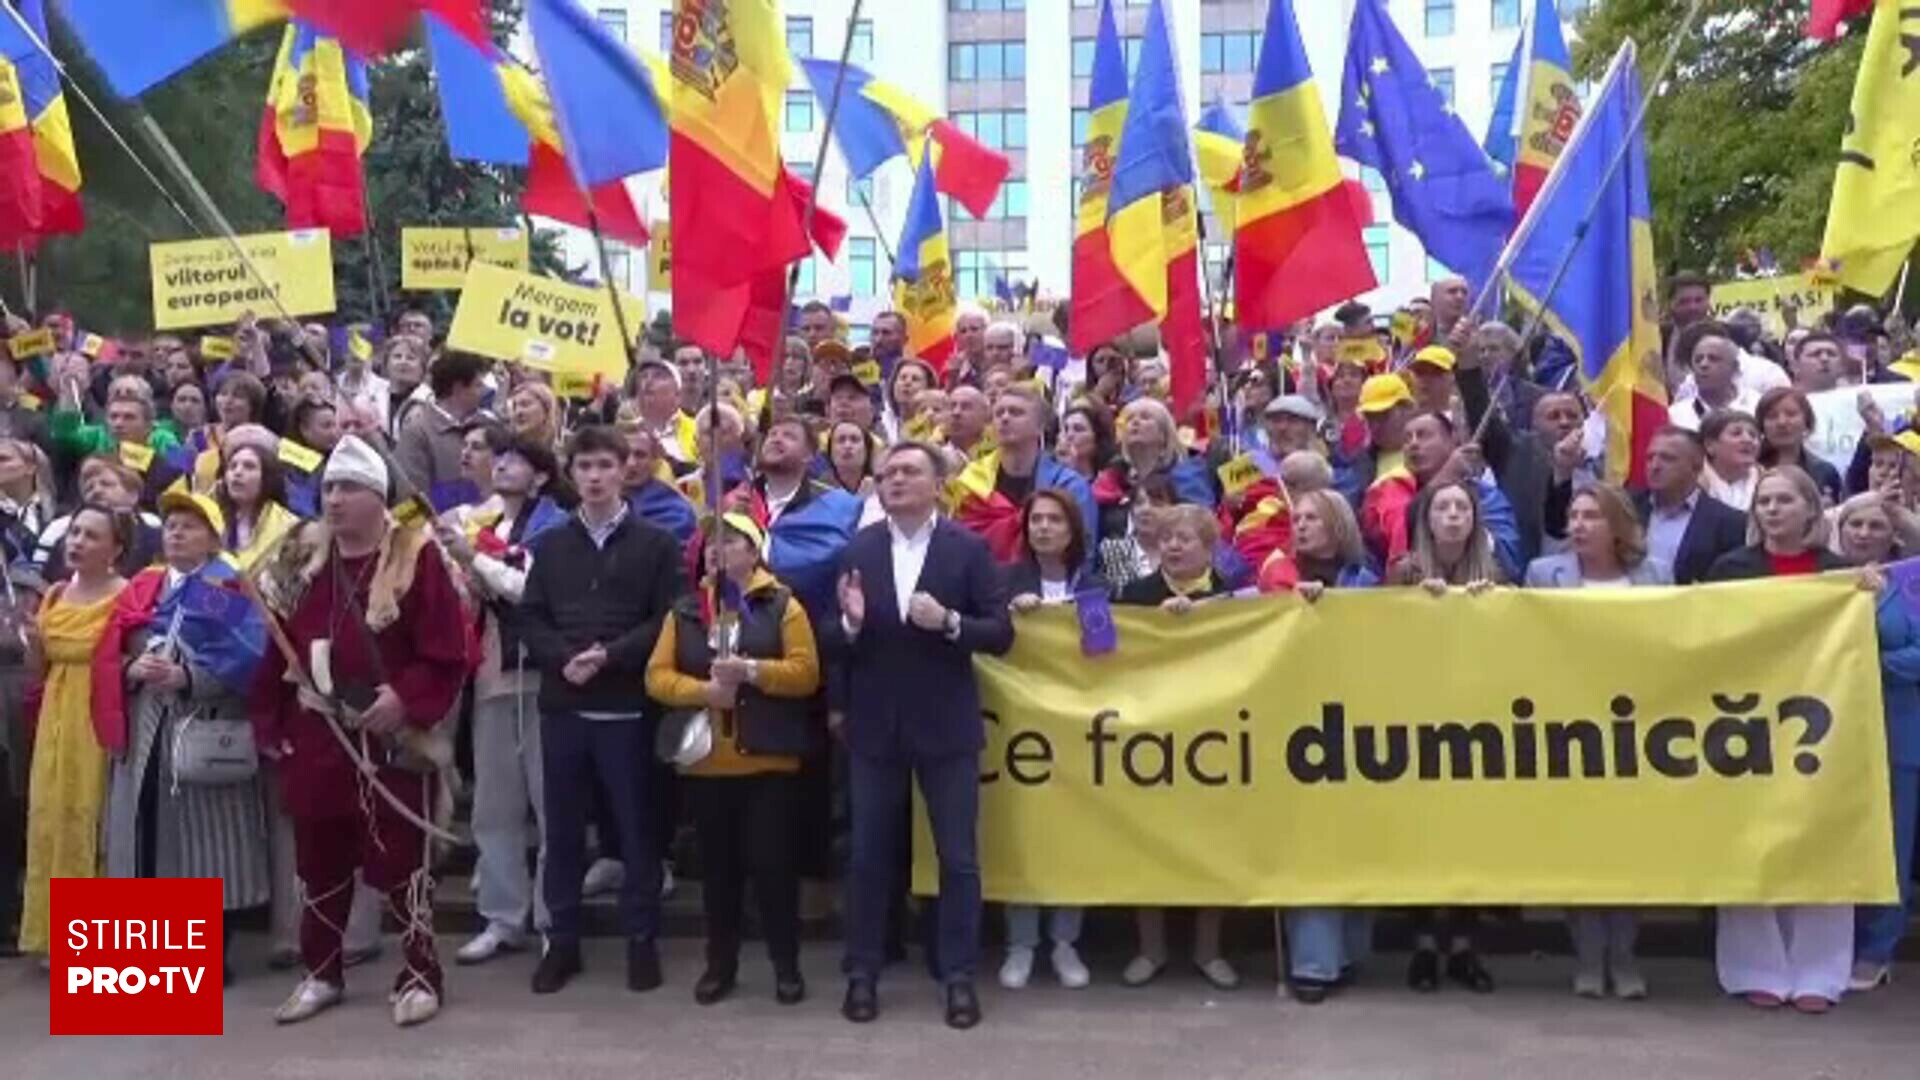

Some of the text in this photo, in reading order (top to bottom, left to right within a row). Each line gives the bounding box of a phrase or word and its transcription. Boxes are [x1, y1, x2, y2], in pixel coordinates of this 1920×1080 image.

[165, 264, 247, 287] viitorul
[513, 281, 598, 318] Mergem
[498, 298, 601, 347] la vot!
[1085, 708, 1252, 787] faci
[1286, 692, 1834, 784] duminică?
